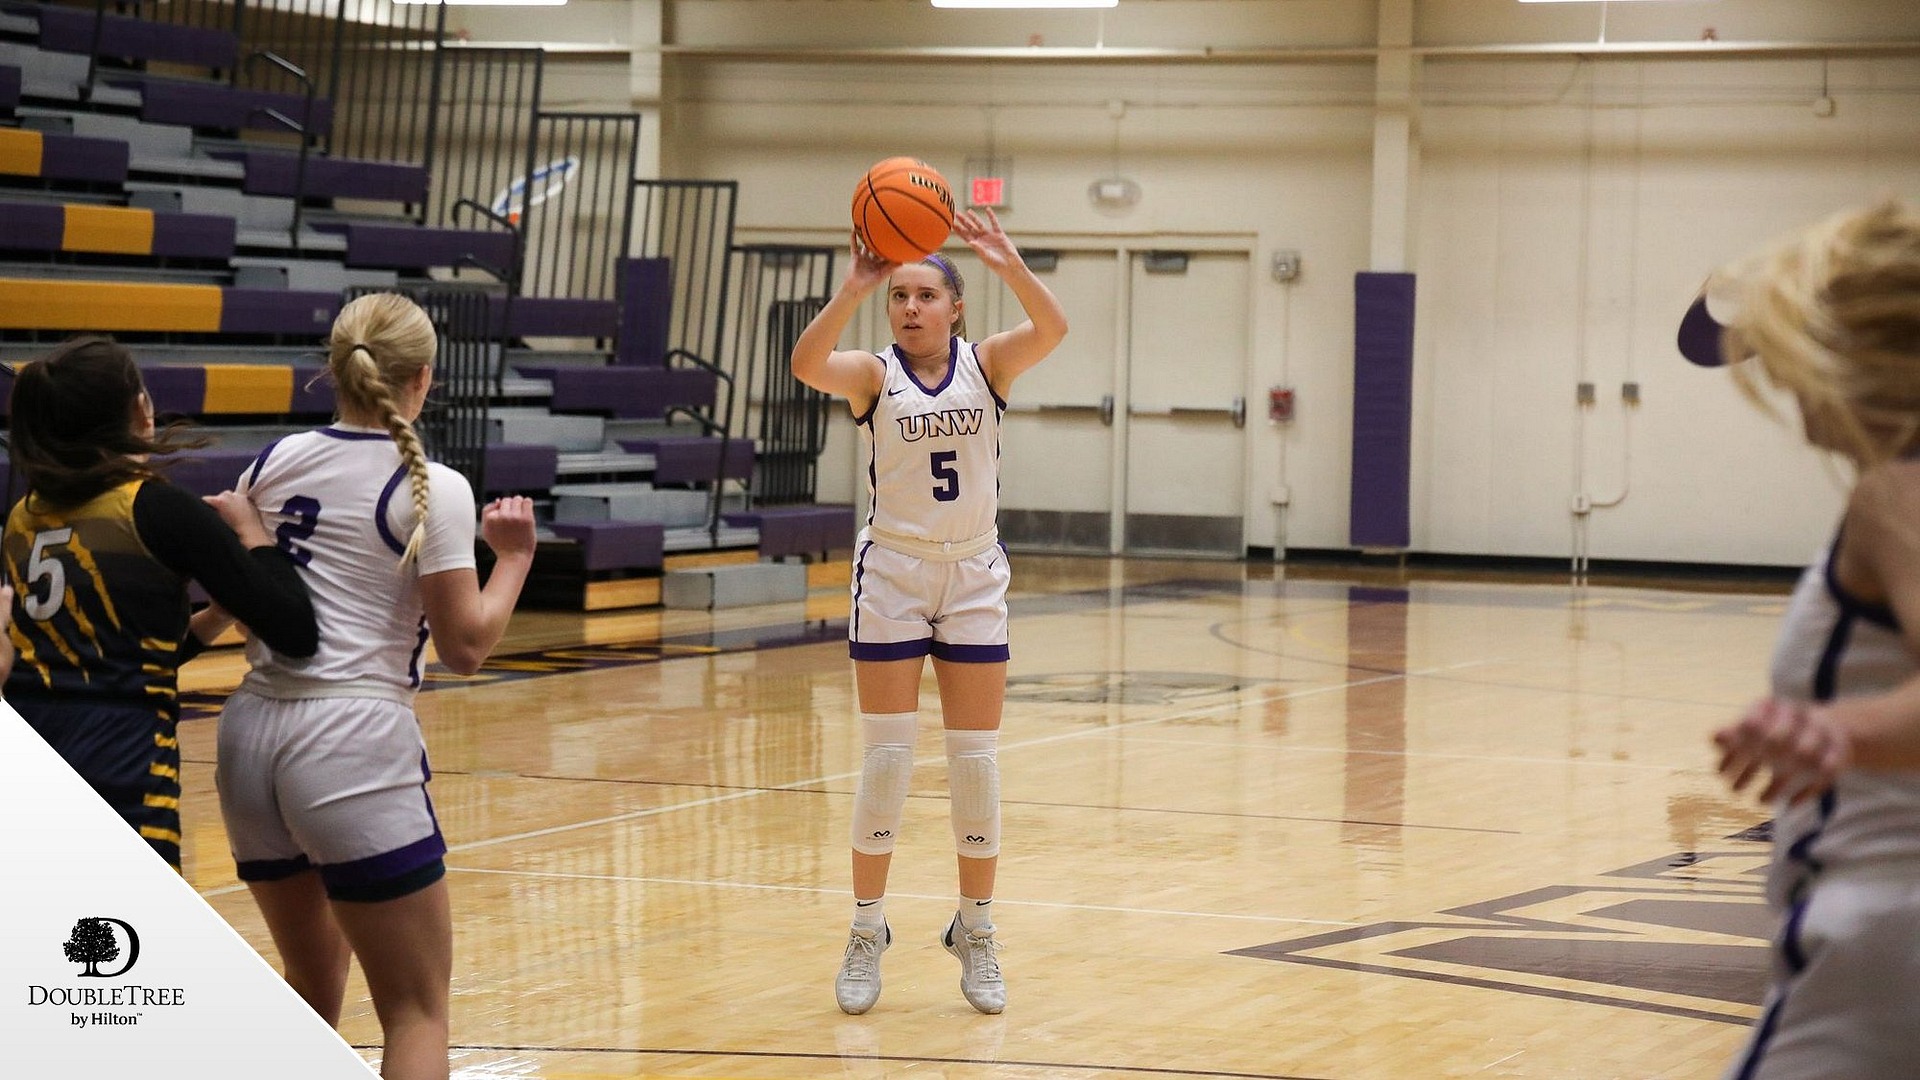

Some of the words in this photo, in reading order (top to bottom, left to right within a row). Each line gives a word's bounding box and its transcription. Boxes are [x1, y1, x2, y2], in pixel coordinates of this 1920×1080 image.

[896, 408, 983, 442] UNW
[930, 450, 960, 502] 5
[276, 495, 321, 568] 2
[25, 527, 73, 621] 5
